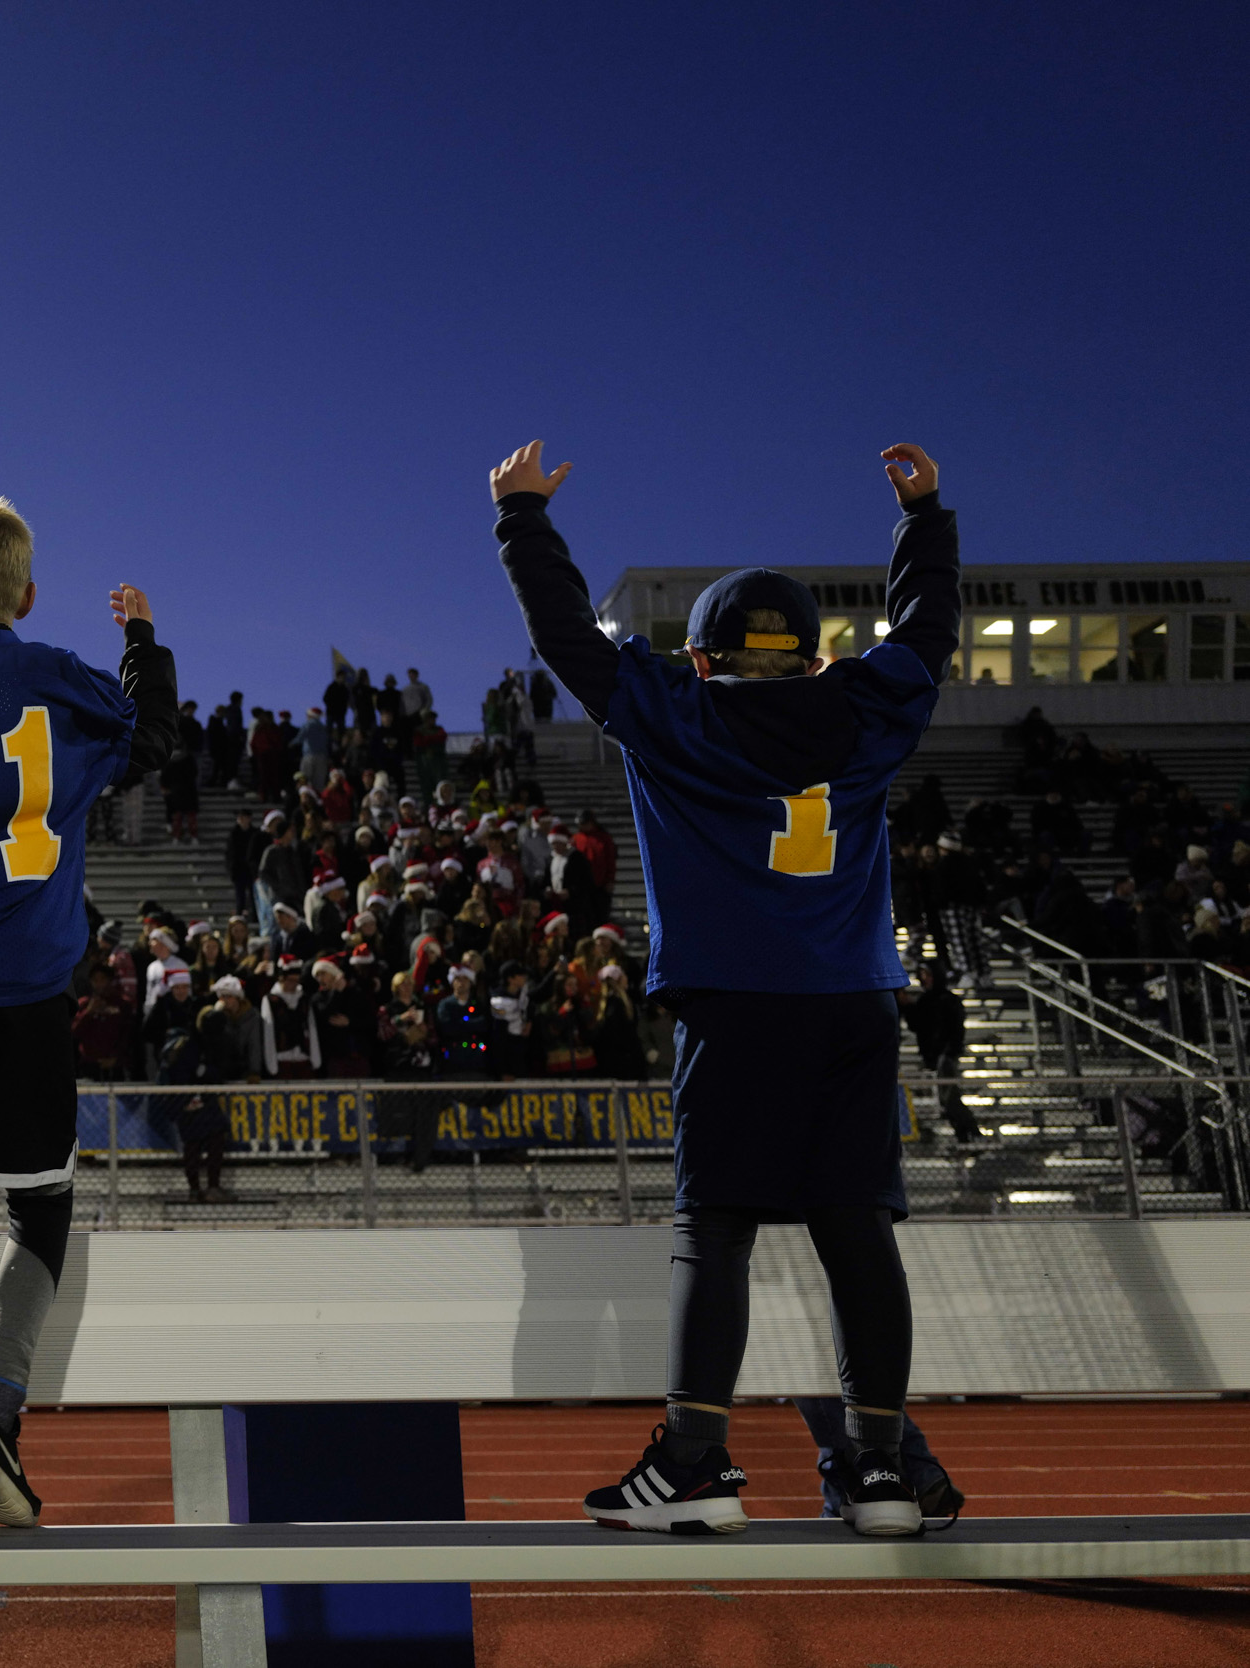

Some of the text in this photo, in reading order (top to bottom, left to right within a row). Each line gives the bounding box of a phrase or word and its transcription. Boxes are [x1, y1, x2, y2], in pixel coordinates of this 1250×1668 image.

[1040, 581, 1098, 606] EVER
[767, 782, 838, 877] 1
[218, 1094, 330, 1142] RTAGE
[863, 1470, 901, 1486] adidas
